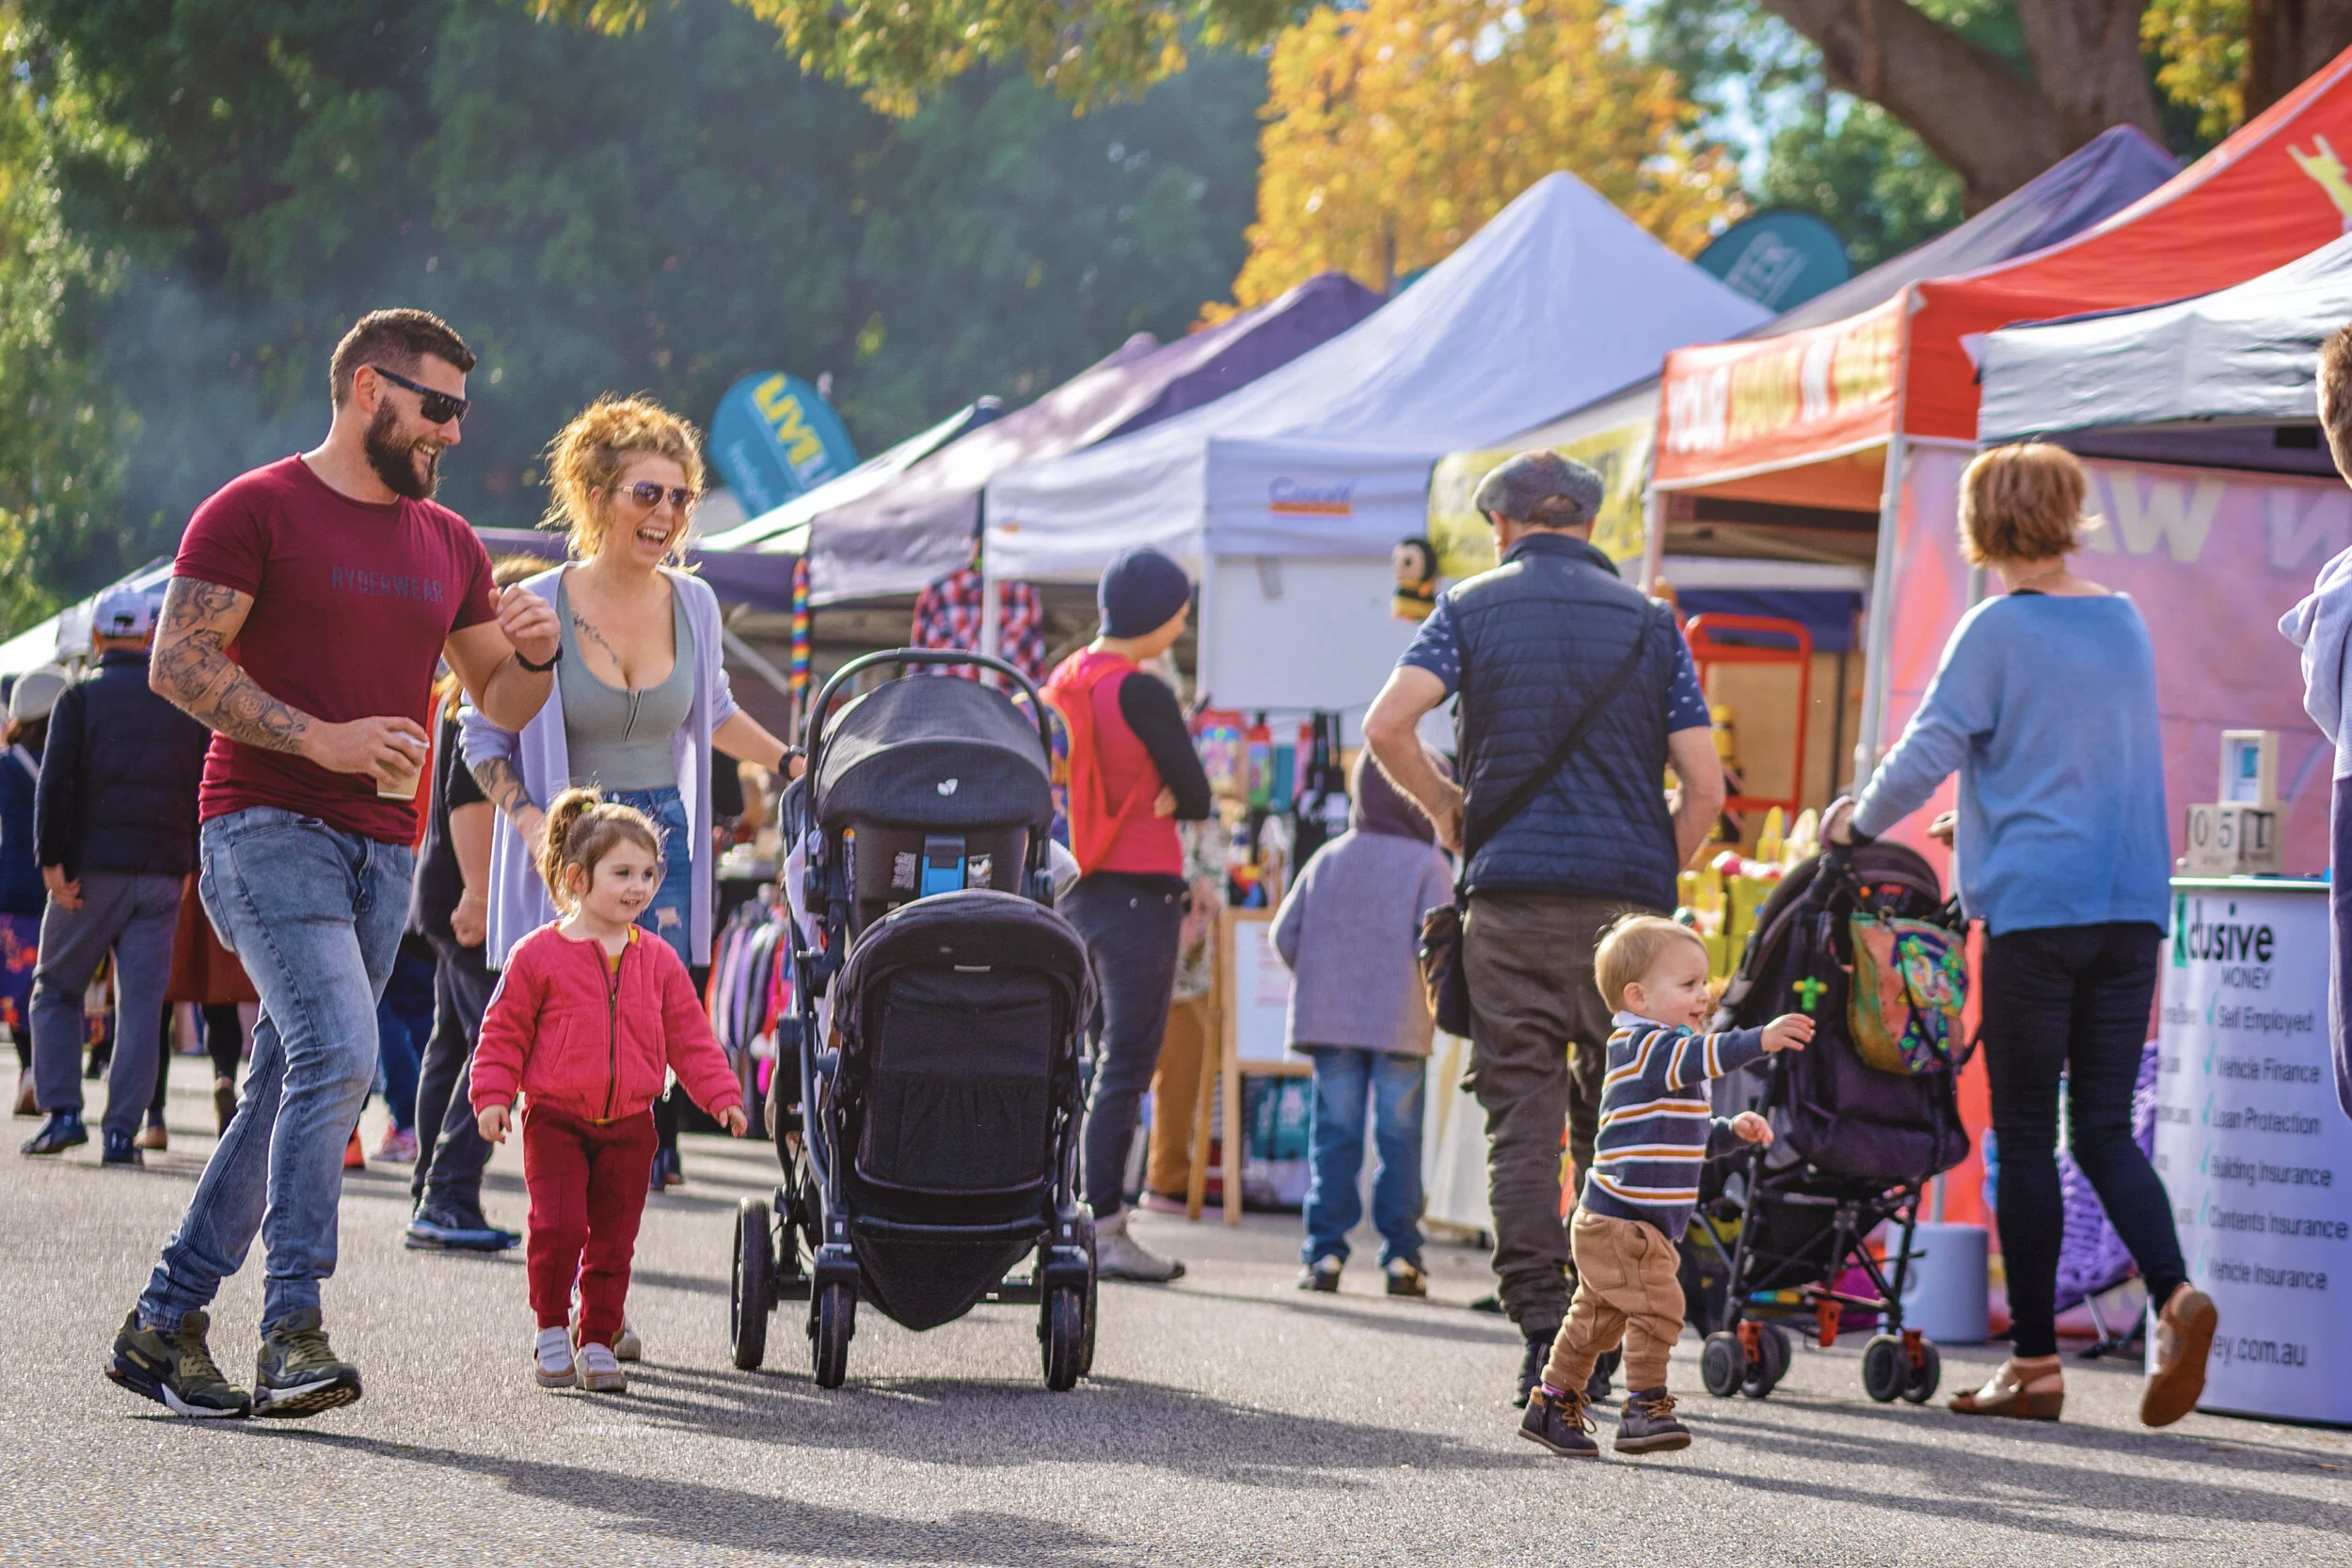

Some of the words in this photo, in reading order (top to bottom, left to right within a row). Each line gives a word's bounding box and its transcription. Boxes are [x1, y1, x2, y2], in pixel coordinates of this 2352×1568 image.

[331, 566, 445, 603] RYDERWEAR
[2221, 966, 2272, 990] MONEY
[2217, 1006, 2239, 1029] Self
[2243, 1006, 2314, 1036] Employed
[2217, 1058, 2259, 1080] Vehicle
[2263, 1057, 2321, 1084] Finance
[2213, 1107, 2240, 1129] Loan
[2245, 1107, 2321, 1134] Protection
[2211, 1156, 2255, 1186] Building
[2259, 1161, 2333, 1188] Insurance
[2208, 1206, 2265, 1233] Contents
[2269, 1212, 2348, 1240] Insurance
[2207, 1258, 2251, 1284] Vehicle
[2255, 1261, 2328, 1291] Insurance
[2211, 1334, 2308, 1368] ey.com.au
